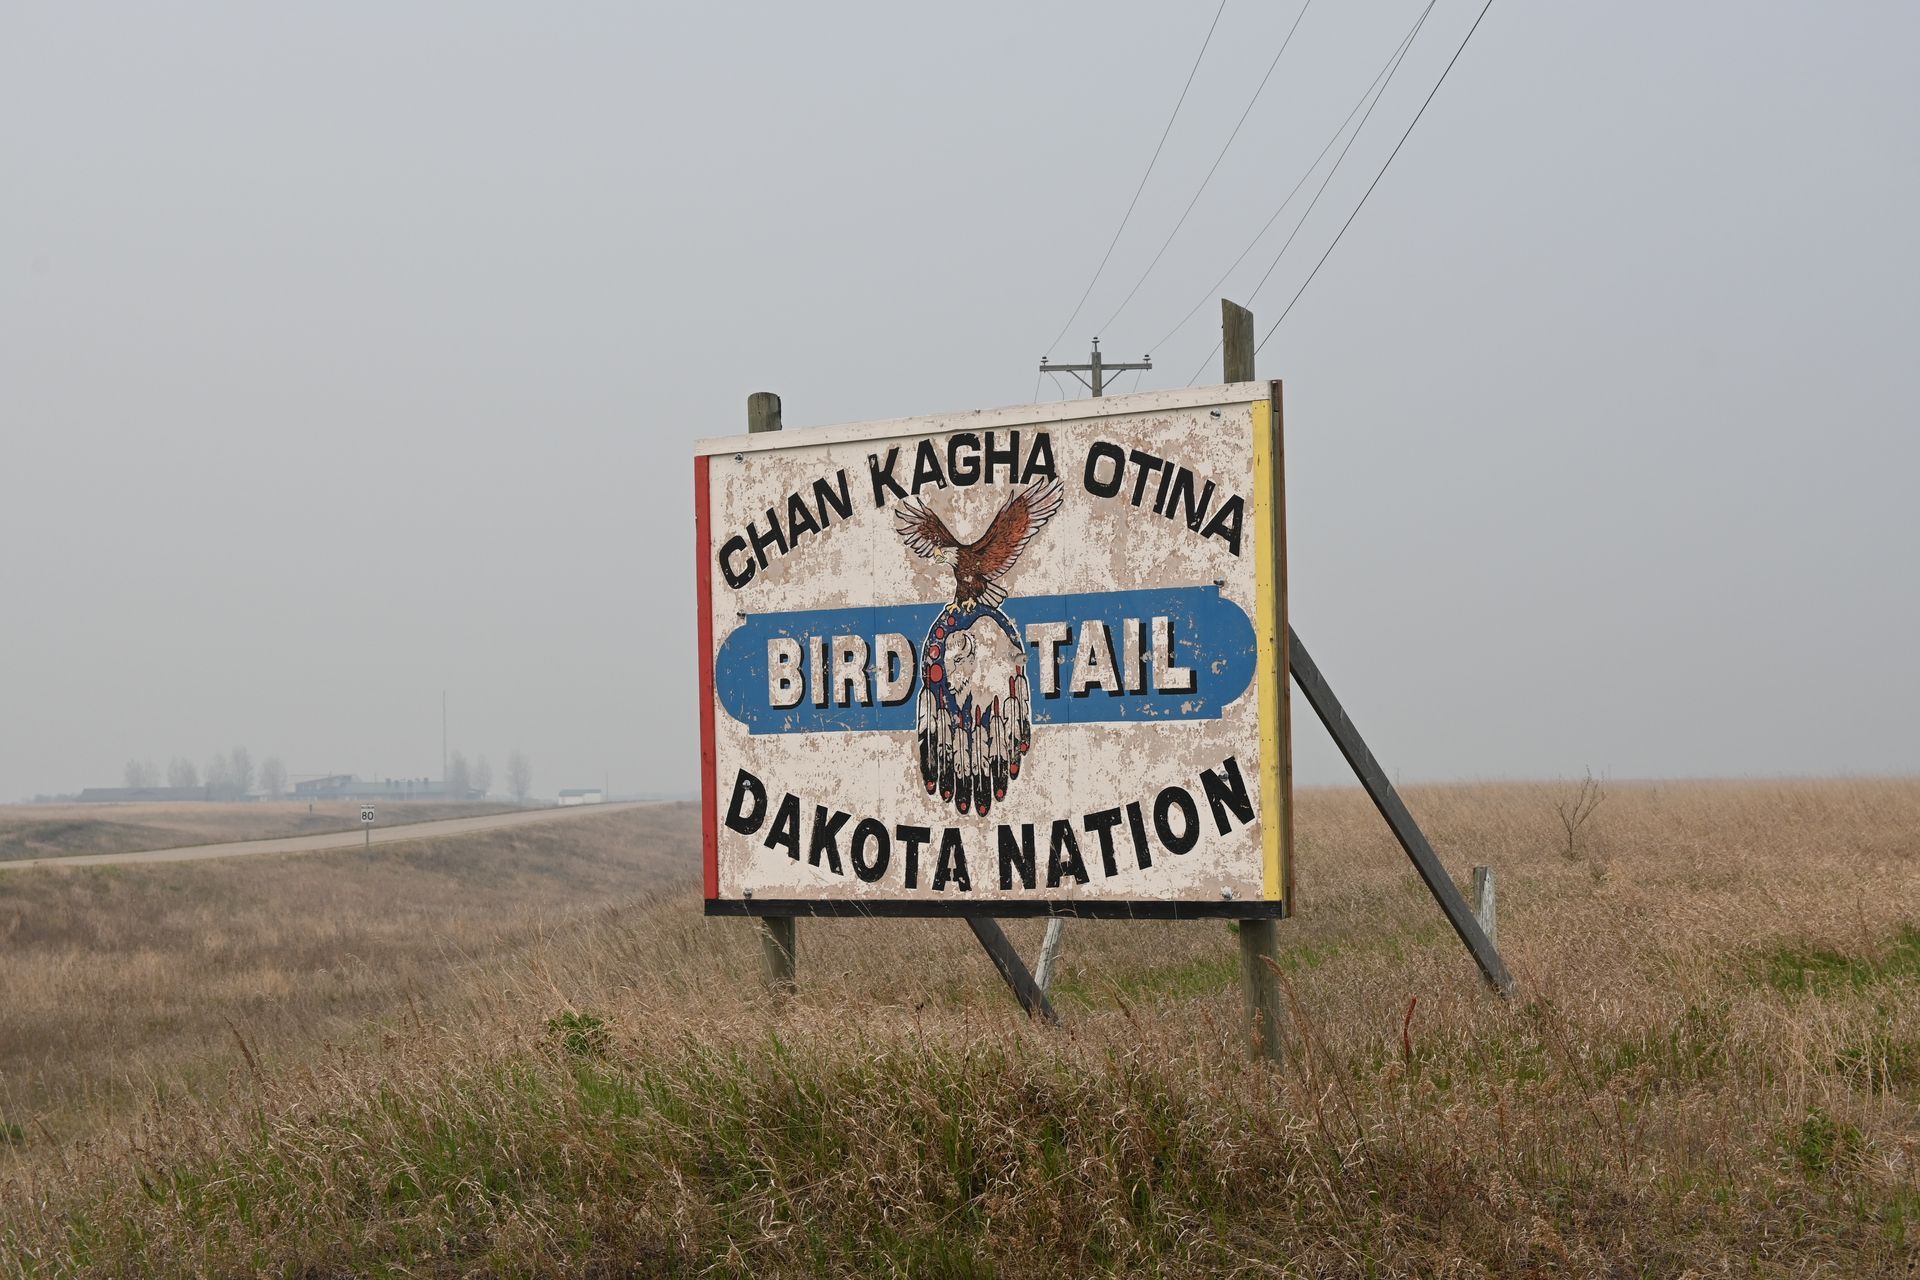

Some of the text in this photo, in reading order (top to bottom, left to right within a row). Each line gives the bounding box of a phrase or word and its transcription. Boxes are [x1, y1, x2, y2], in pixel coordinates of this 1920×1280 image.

[718, 431, 1247, 590] CHAN KAGHA OTINA
[767, 616, 1197, 710] BIRD TAIL
[361, 811, 374, 820] 80
[724, 756, 1256, 892] DAKOTA NATION
